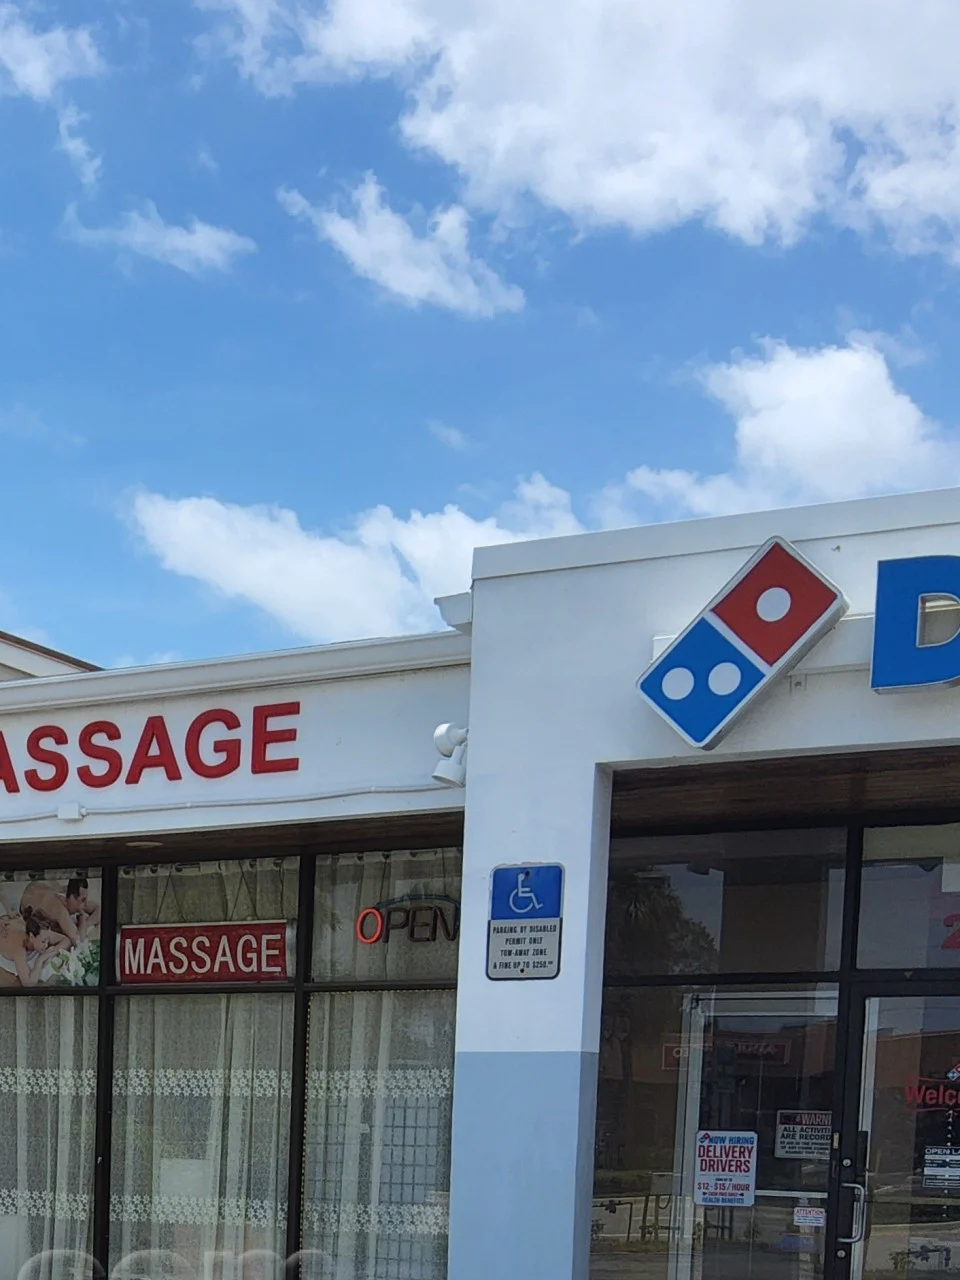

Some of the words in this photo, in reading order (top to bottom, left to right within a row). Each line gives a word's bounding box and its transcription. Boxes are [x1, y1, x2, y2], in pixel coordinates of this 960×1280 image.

[355, 903, 460, 944] OPEN
[493, 926, 517, 934] PARKING
[530, 924, 557, 933] DISABLED
[505, 937, 526, 945] PERMIT
[529, 937, 543, 945] ONLY
[124, 934, 282, 975] MASSAGE
[500, 949, 529, 957] TOW-AWAY
[532, 948, 547, 956] ZONE
[513, 961, 520, 969] UP
[523, 961, 530, 969] TO
[903, 1084, 960, 1106] Welc
[708, 1136, 727, 1144] NOW
[728, 1136, 754, 1145] HIRING
[698, 1145, 754, 1159] DELIVERY
[700, 1159, 751, 1173] DRIVERS
[697, 1182, 709, 1190] $12
[714, 1182, 726, 1191] $15
[732, 1183, 750, 1191] HOUR
